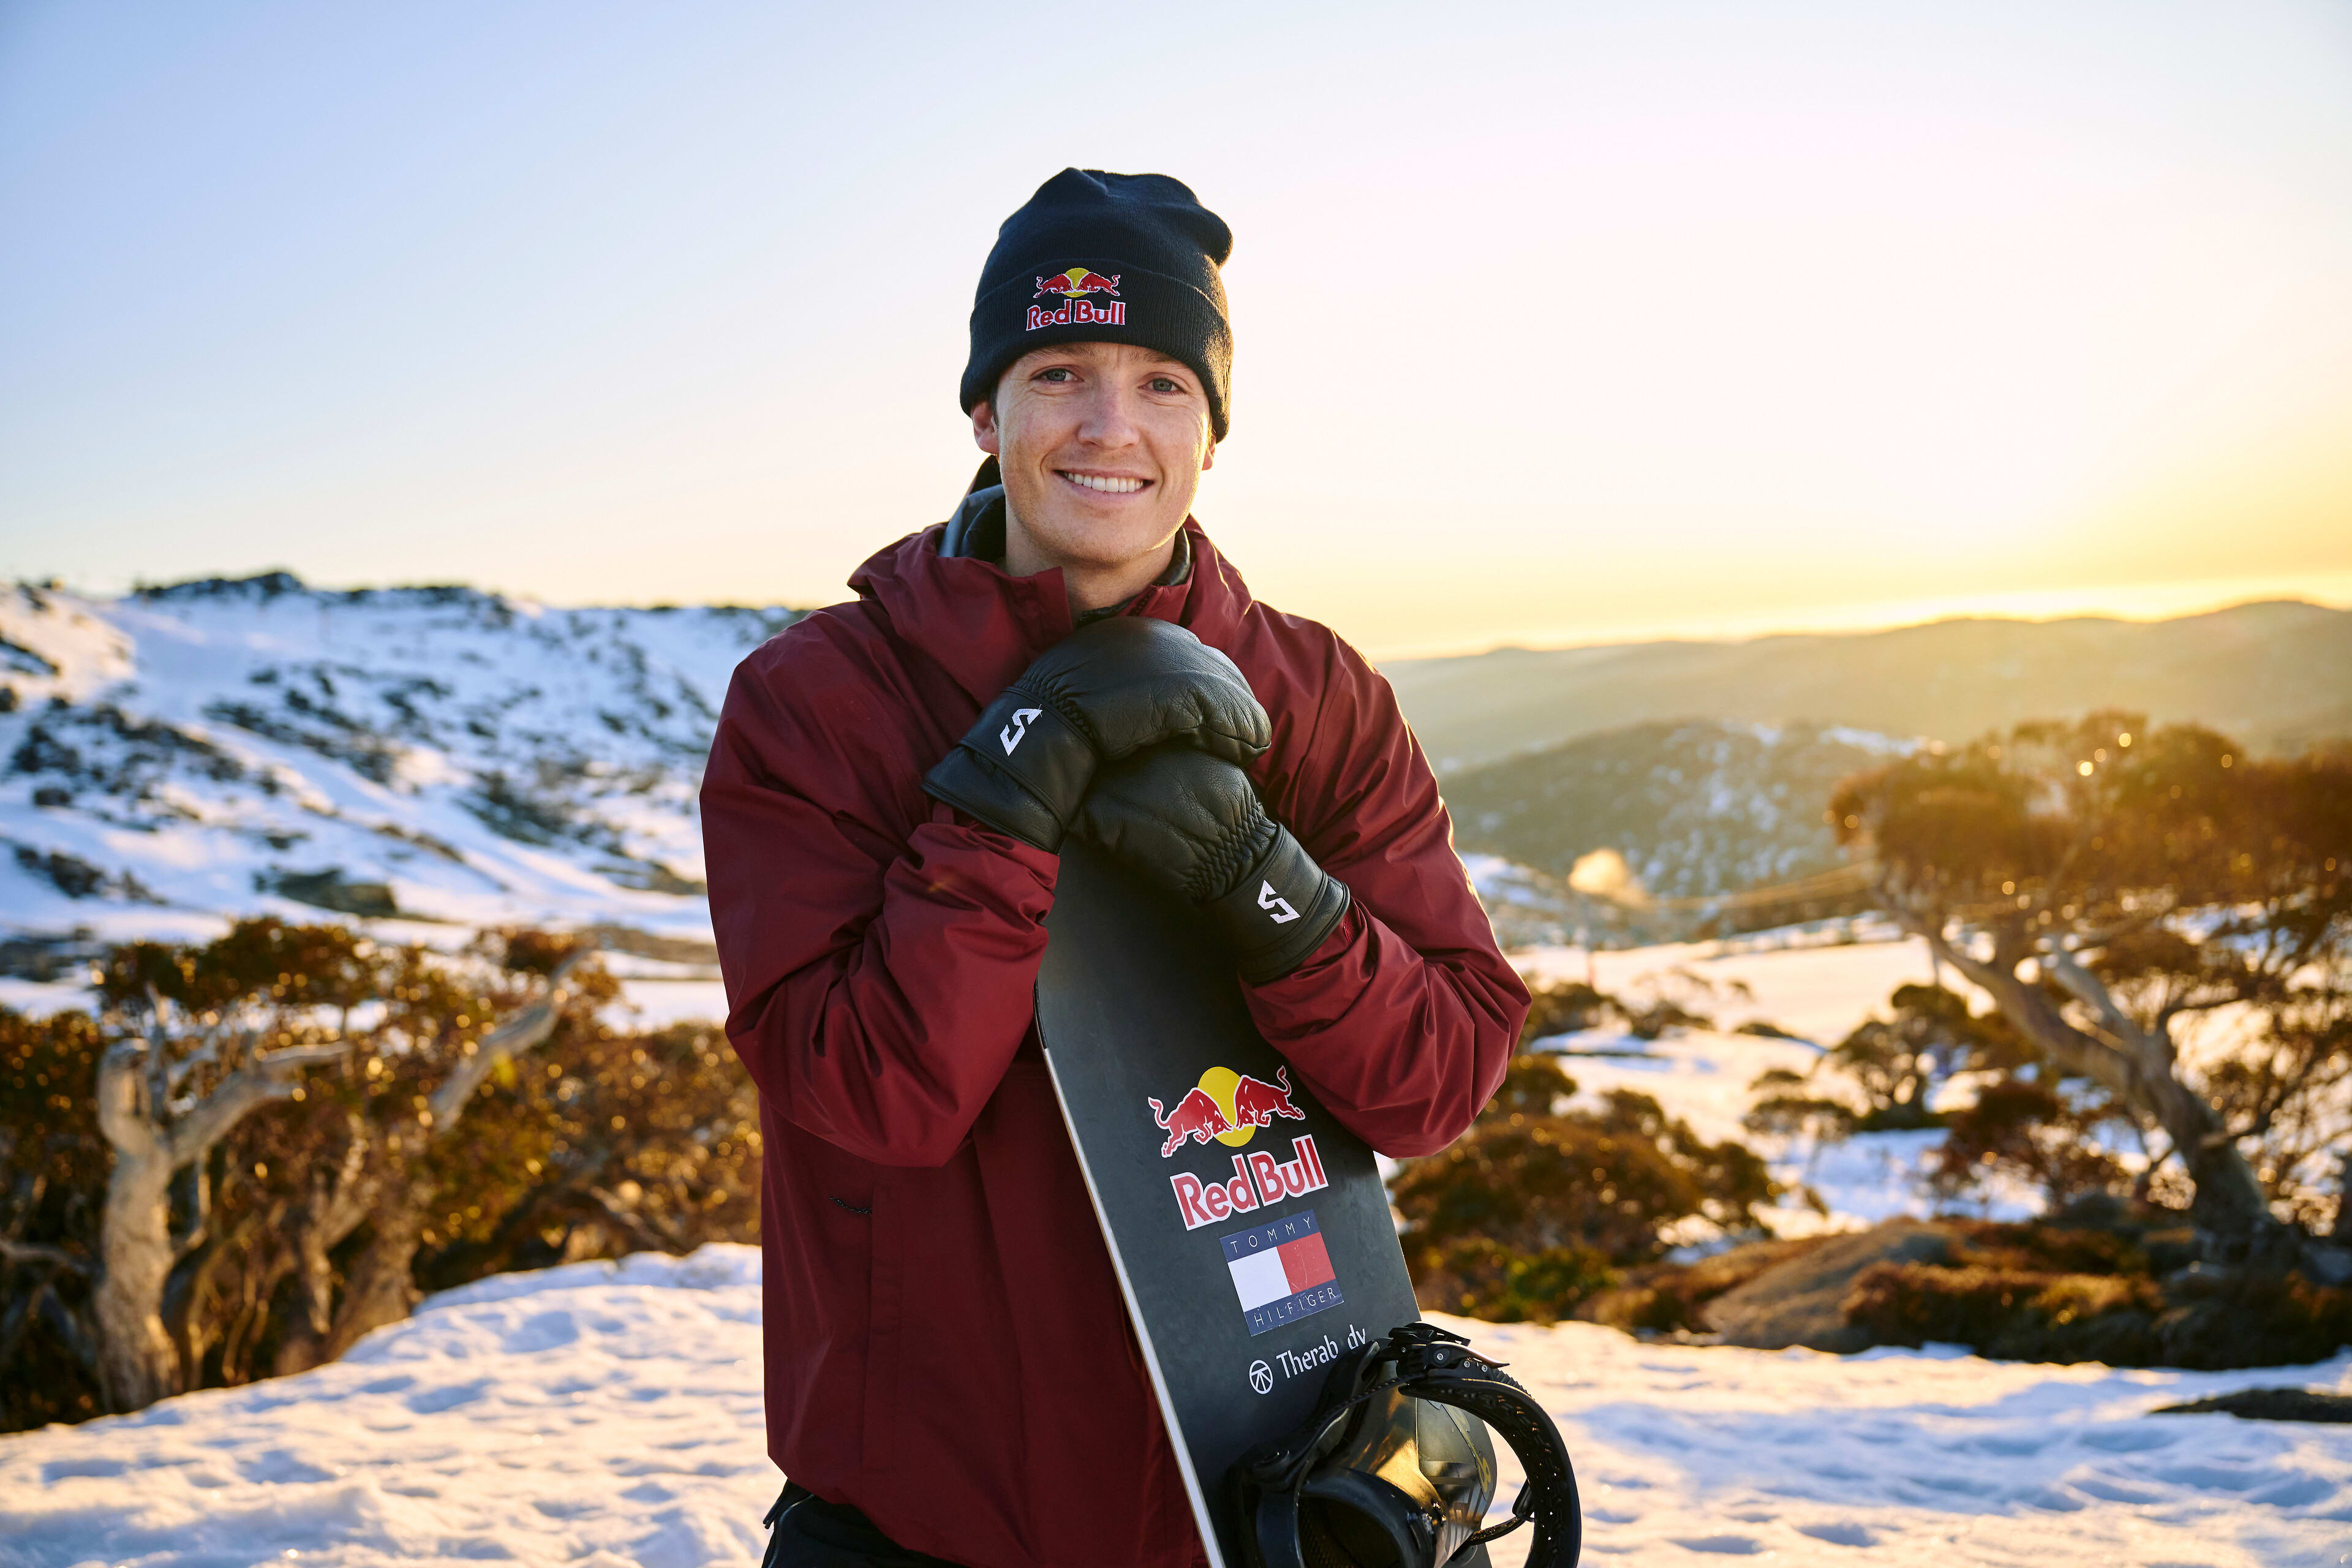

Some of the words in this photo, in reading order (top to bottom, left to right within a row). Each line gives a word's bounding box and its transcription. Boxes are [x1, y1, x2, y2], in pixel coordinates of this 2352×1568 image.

[1026, 299, 1071, 331] Red
[1074, 300, 1126, 325] Bull
[1170, 1153, 1259, 1231] Red
[1247, 1134, 1329, 1206] Bull
[1230, 1216, 1311, 1254] TOMMY
[1254, 1287, 1338, 1327] HILFIGER
[1276, 1324, 1366, 1379] Therabdy
